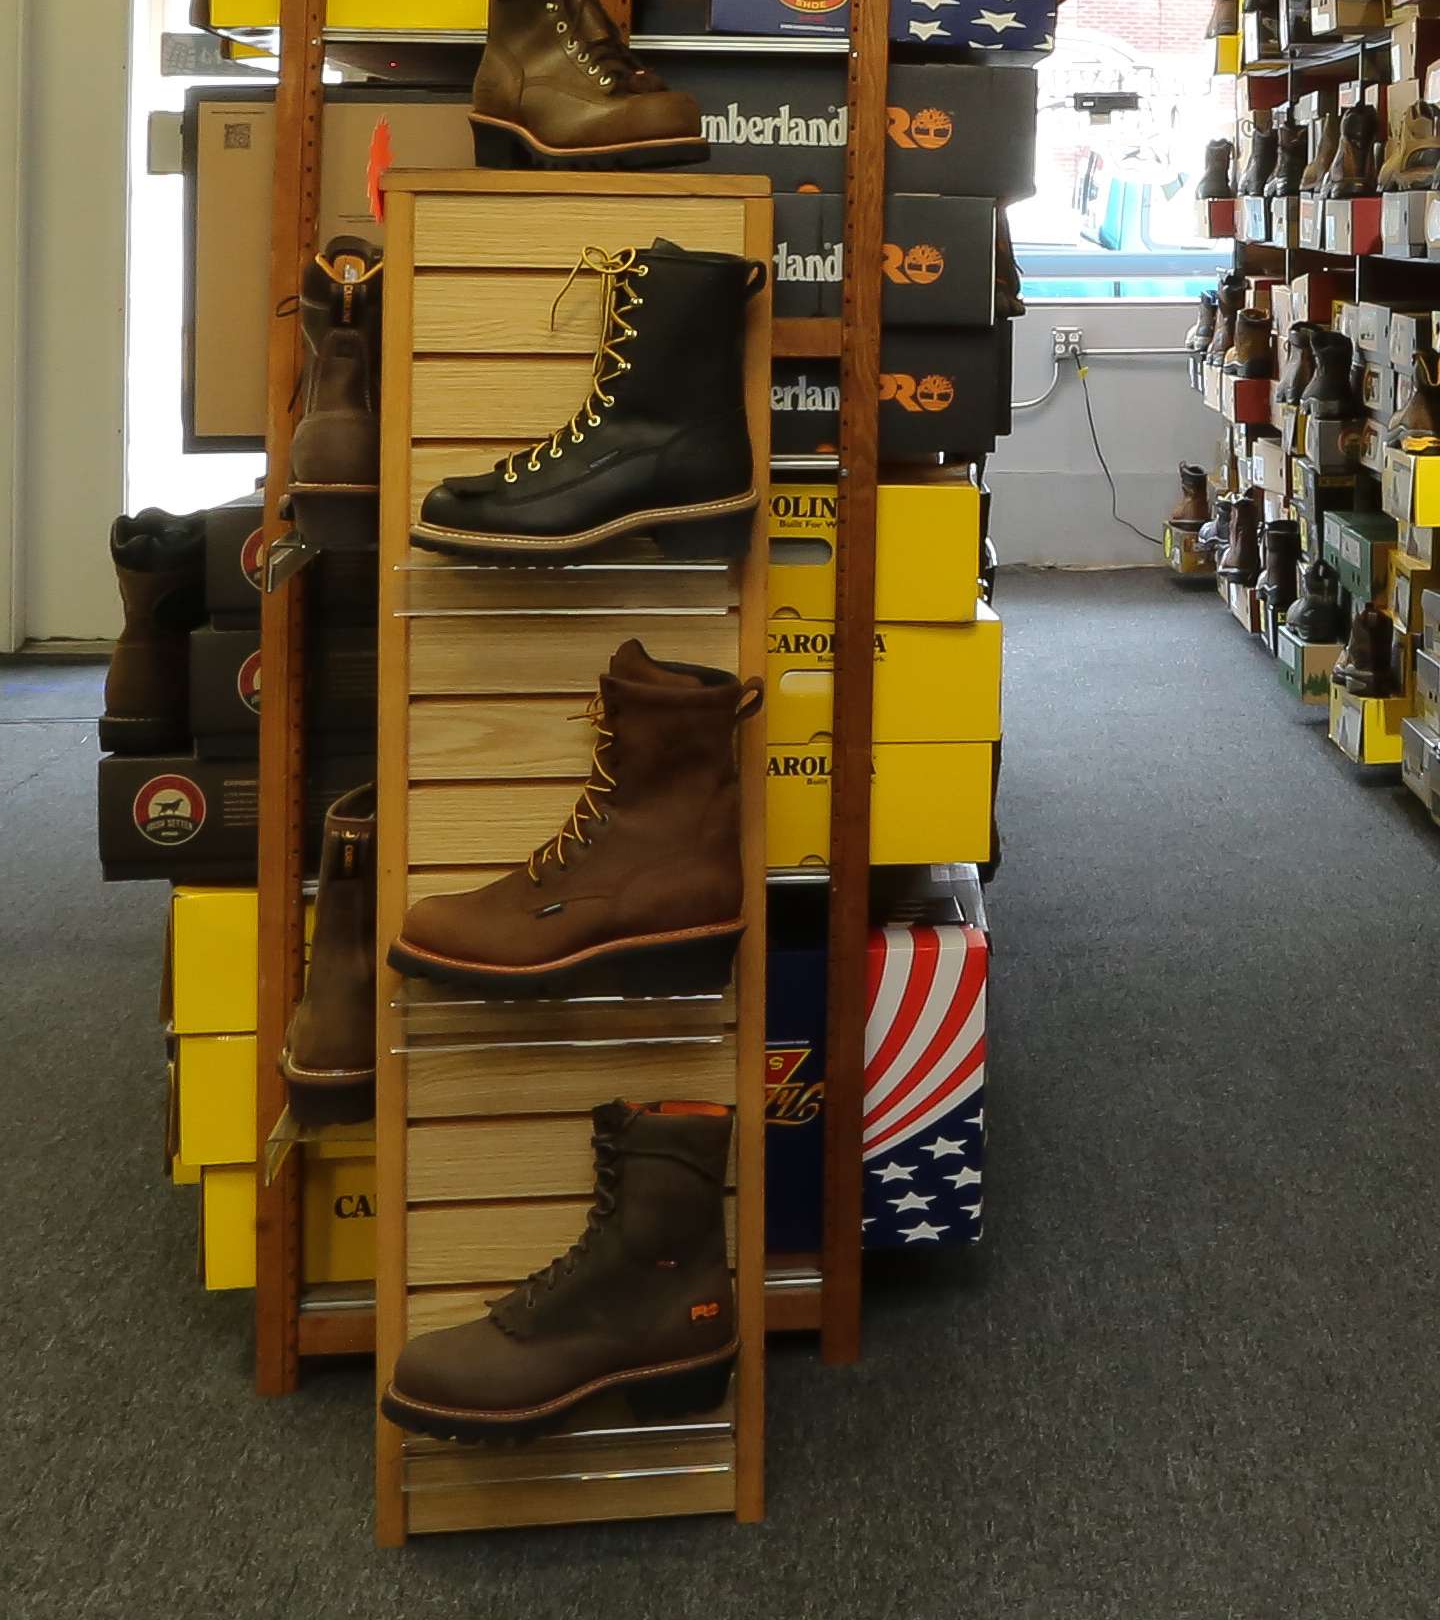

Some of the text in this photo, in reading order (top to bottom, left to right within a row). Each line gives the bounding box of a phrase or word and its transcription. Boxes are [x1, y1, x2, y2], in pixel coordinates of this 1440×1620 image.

[701, 102, 953, 149] mberland RO
[881, 244, 944, 284] RO
